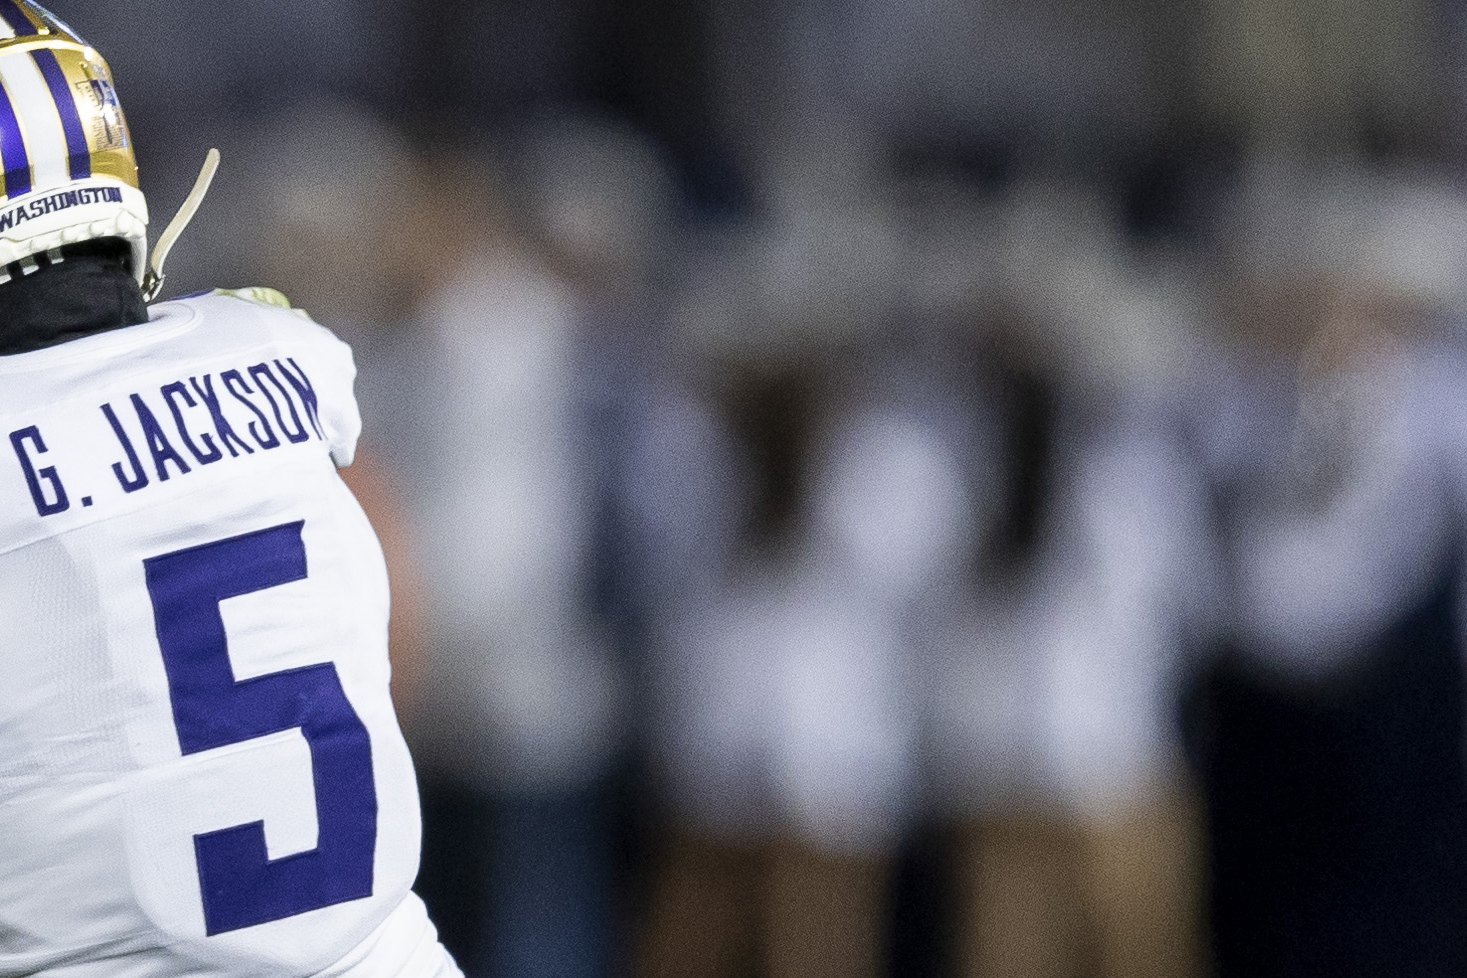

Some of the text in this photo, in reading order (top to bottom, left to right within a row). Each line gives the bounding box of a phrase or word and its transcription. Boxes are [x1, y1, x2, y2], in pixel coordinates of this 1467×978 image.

[9, 356, 326, 517] G. JACKSON
[142, 519, 379, 937] 5
